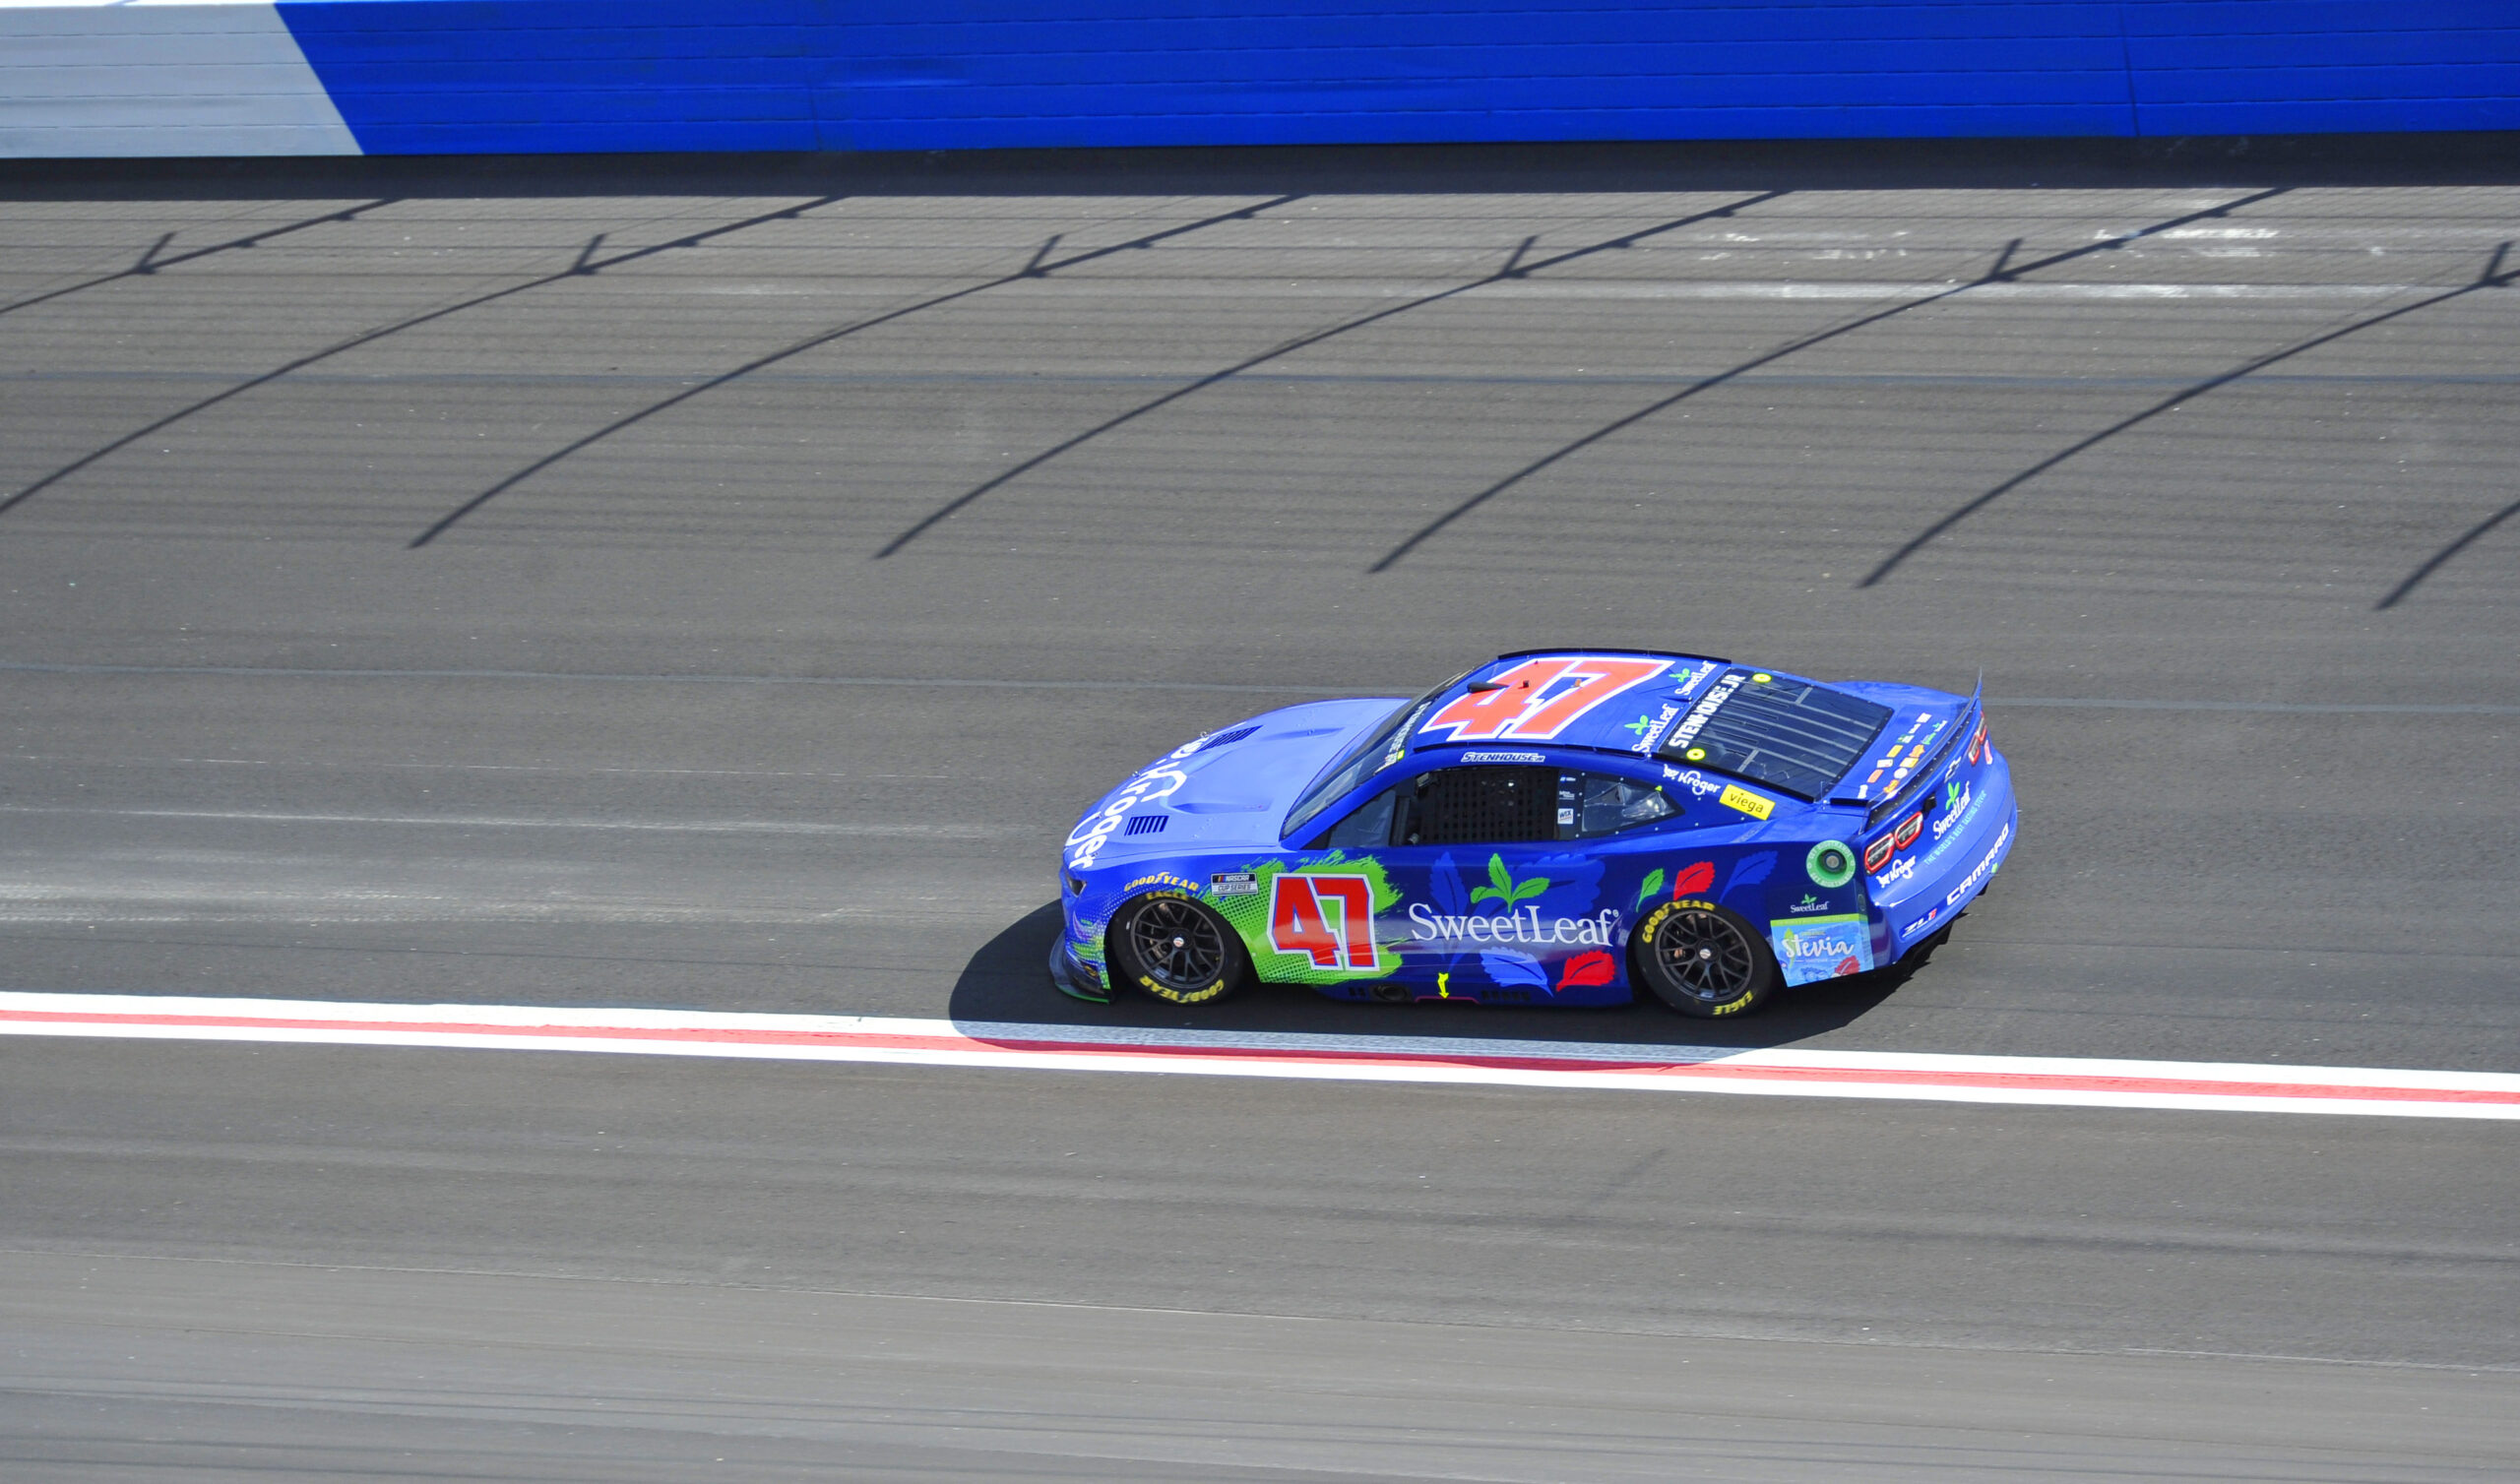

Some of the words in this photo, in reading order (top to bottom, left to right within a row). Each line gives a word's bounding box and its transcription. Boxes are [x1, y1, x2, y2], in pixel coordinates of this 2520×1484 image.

[1674, 660, 1718, 696] SweetLeaf
[1418, 656, 1676, 742] 47
[1669, 686, 1734, 749] STENHOUSE
[1720, 673, 1746, 689] JR
[1632, 704, 1679, 753] SweetLeaf
[1461, 752, 1538, 762] STENHOUSE
[1677, 771, 1721, 795] Kroger
[1065, 761, 1187, 870] Kroger
[1731, 792, 1764, 813] viega
[1932, 780, 1971, 840] SweetLeaf
[1124, 872, 1199, 892] GOODYEAR
[1890, 855, 1916, 880] Kroger
[1946, 823, 2009, 905] CAMARO
[1267, 873, 1380, 971] 47
[1642, 899, 1716, 944] GOODYEAR
[1790, 900, 1830, 913] SweetLeaf
[1140, 974, 1225, 1004] GOODYEAR
[1712, 990, 1753, 1016] EAGLE
